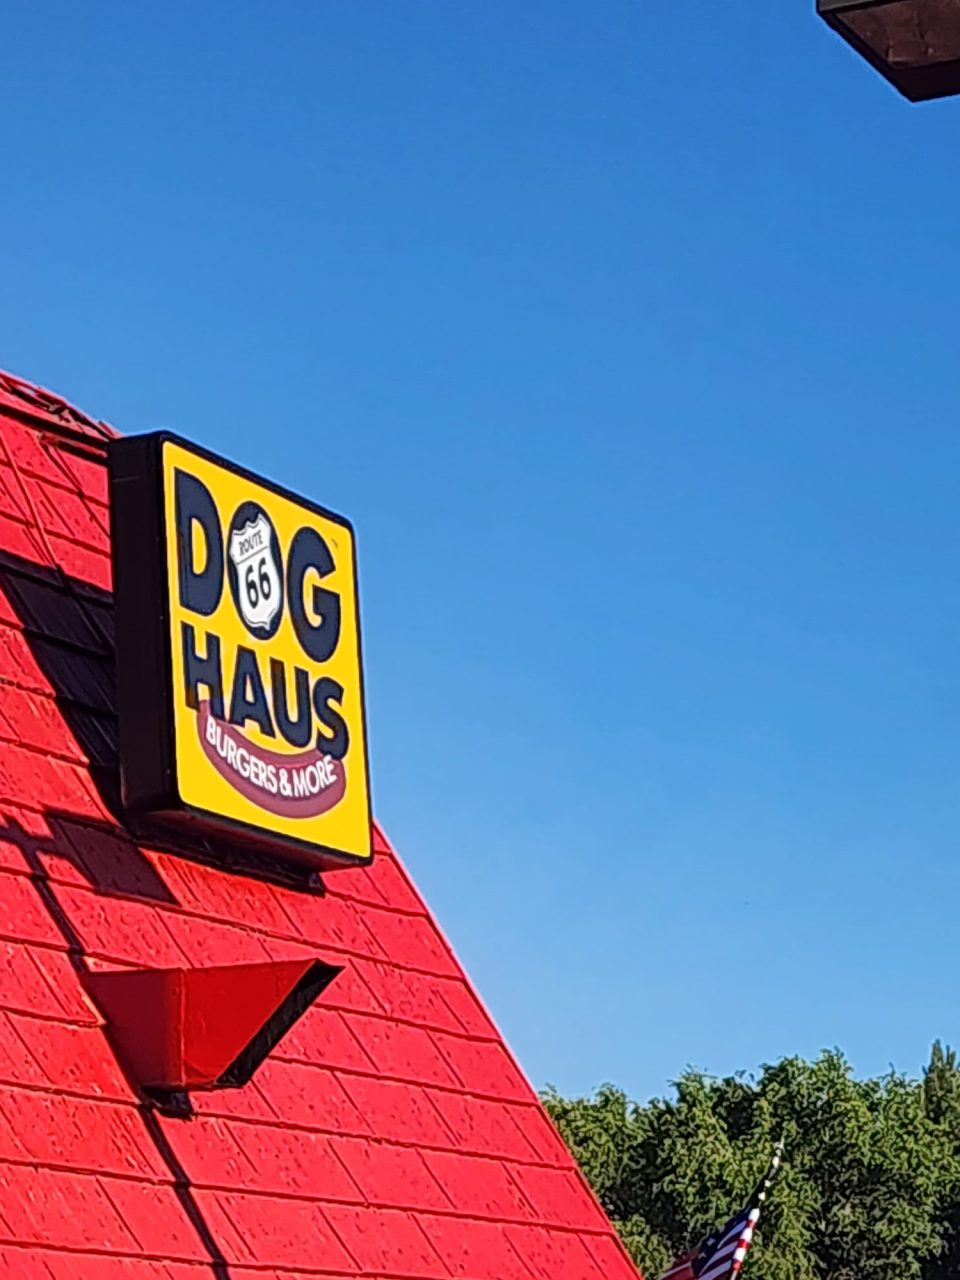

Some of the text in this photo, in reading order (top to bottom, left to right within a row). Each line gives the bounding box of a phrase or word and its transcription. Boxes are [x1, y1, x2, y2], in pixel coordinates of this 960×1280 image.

[174, 466, 341, 663] DOG
[238, 530, 264, 556] ROUTE
[245, 557, 271, 609] 66
[181, 620, 350, 761] HAUS
[206, 716, 338, 798] BURGERS & MORE
